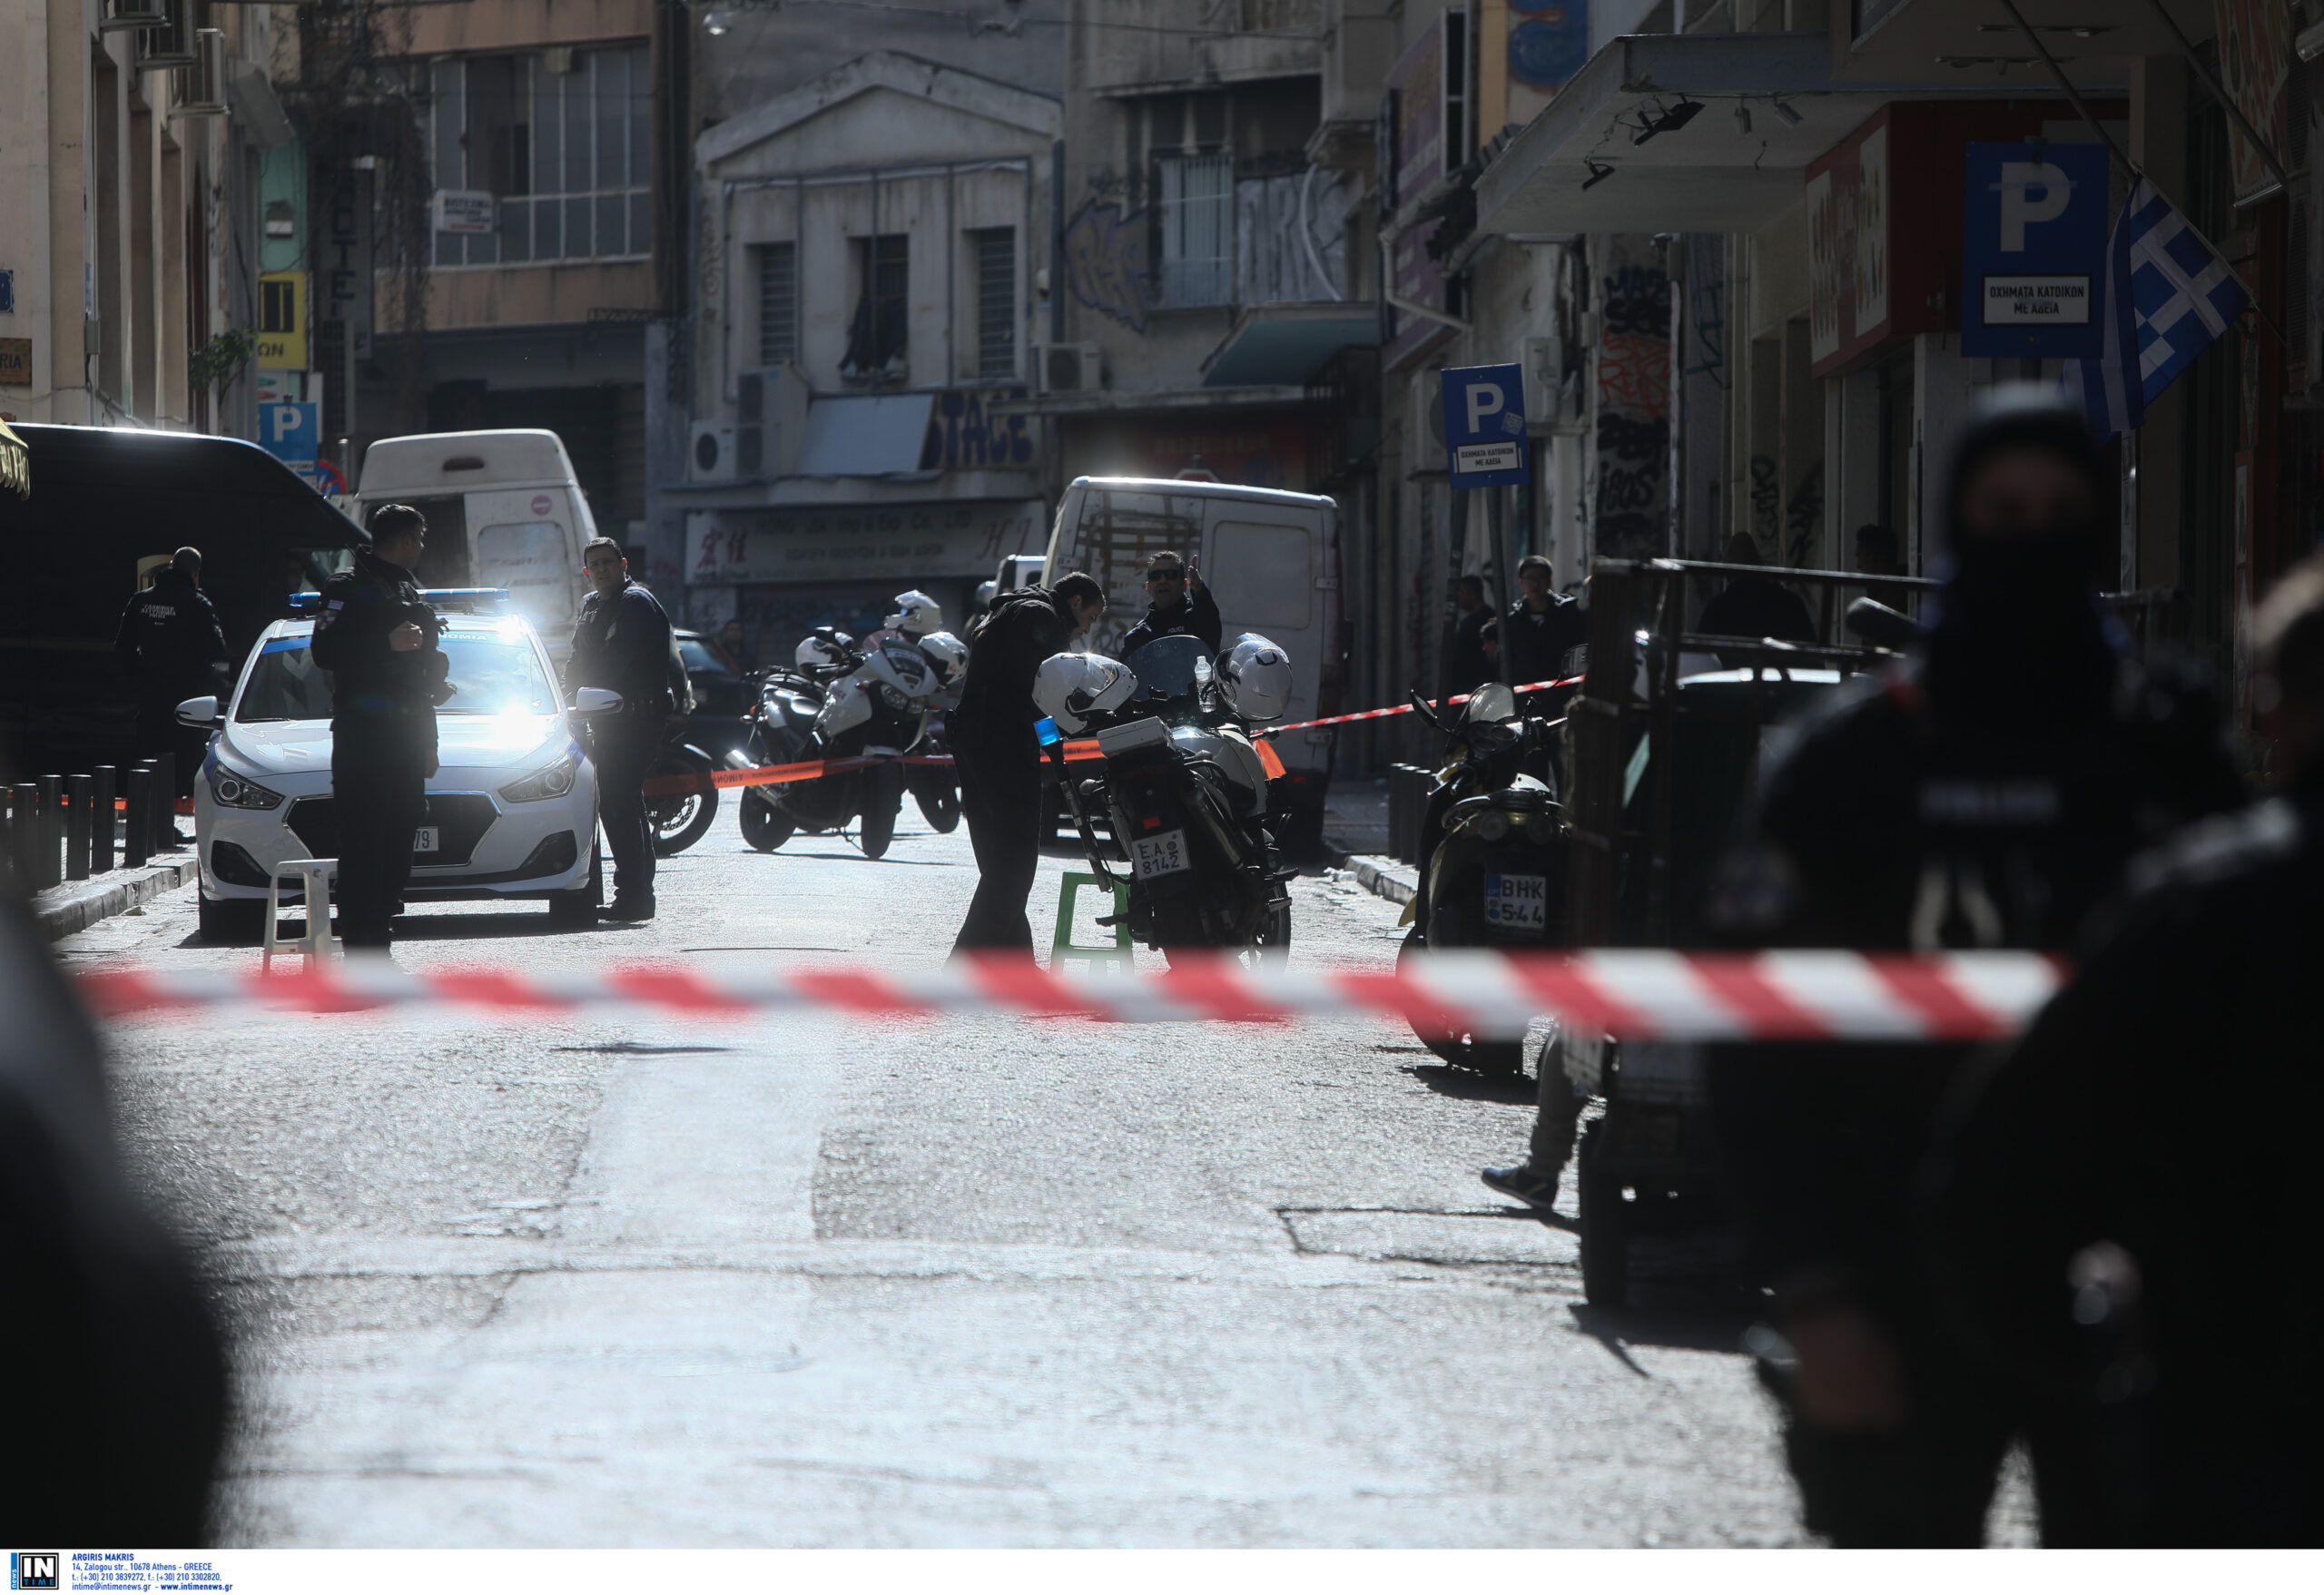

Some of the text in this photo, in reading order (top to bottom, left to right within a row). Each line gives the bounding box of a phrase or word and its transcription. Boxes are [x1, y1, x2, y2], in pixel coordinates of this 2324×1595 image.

[2000, 162, 2071, 252] P
[1990, 286, 2084, 298] ΟΧΗΜΑΤΑ ΚΑΤΟΙΚΩΝ
[2014, 302, 2060, 314] ΜΕ ΑΔΕΙΑ
[1466, 382, 1504, 433] P
[273, 406, 303, 442] P
[1460, 447, 1514, 458] ΟΧΗΜΑΤΑ ΚΑΤΟΙΚΩΝ
[1475, 458, 1502, 467] ΜΕ ΑΔΕΙΑ
[1167, 625, 1185, 634] POLICE
[415, 830, 429, 850] 79
[1138, 842, 1167, 860] E.A.
[1142, 854, 1180, 874] 8142
[1502, 879, 1543, 899] BHK
[1502, 903, 1543, 923] 544
